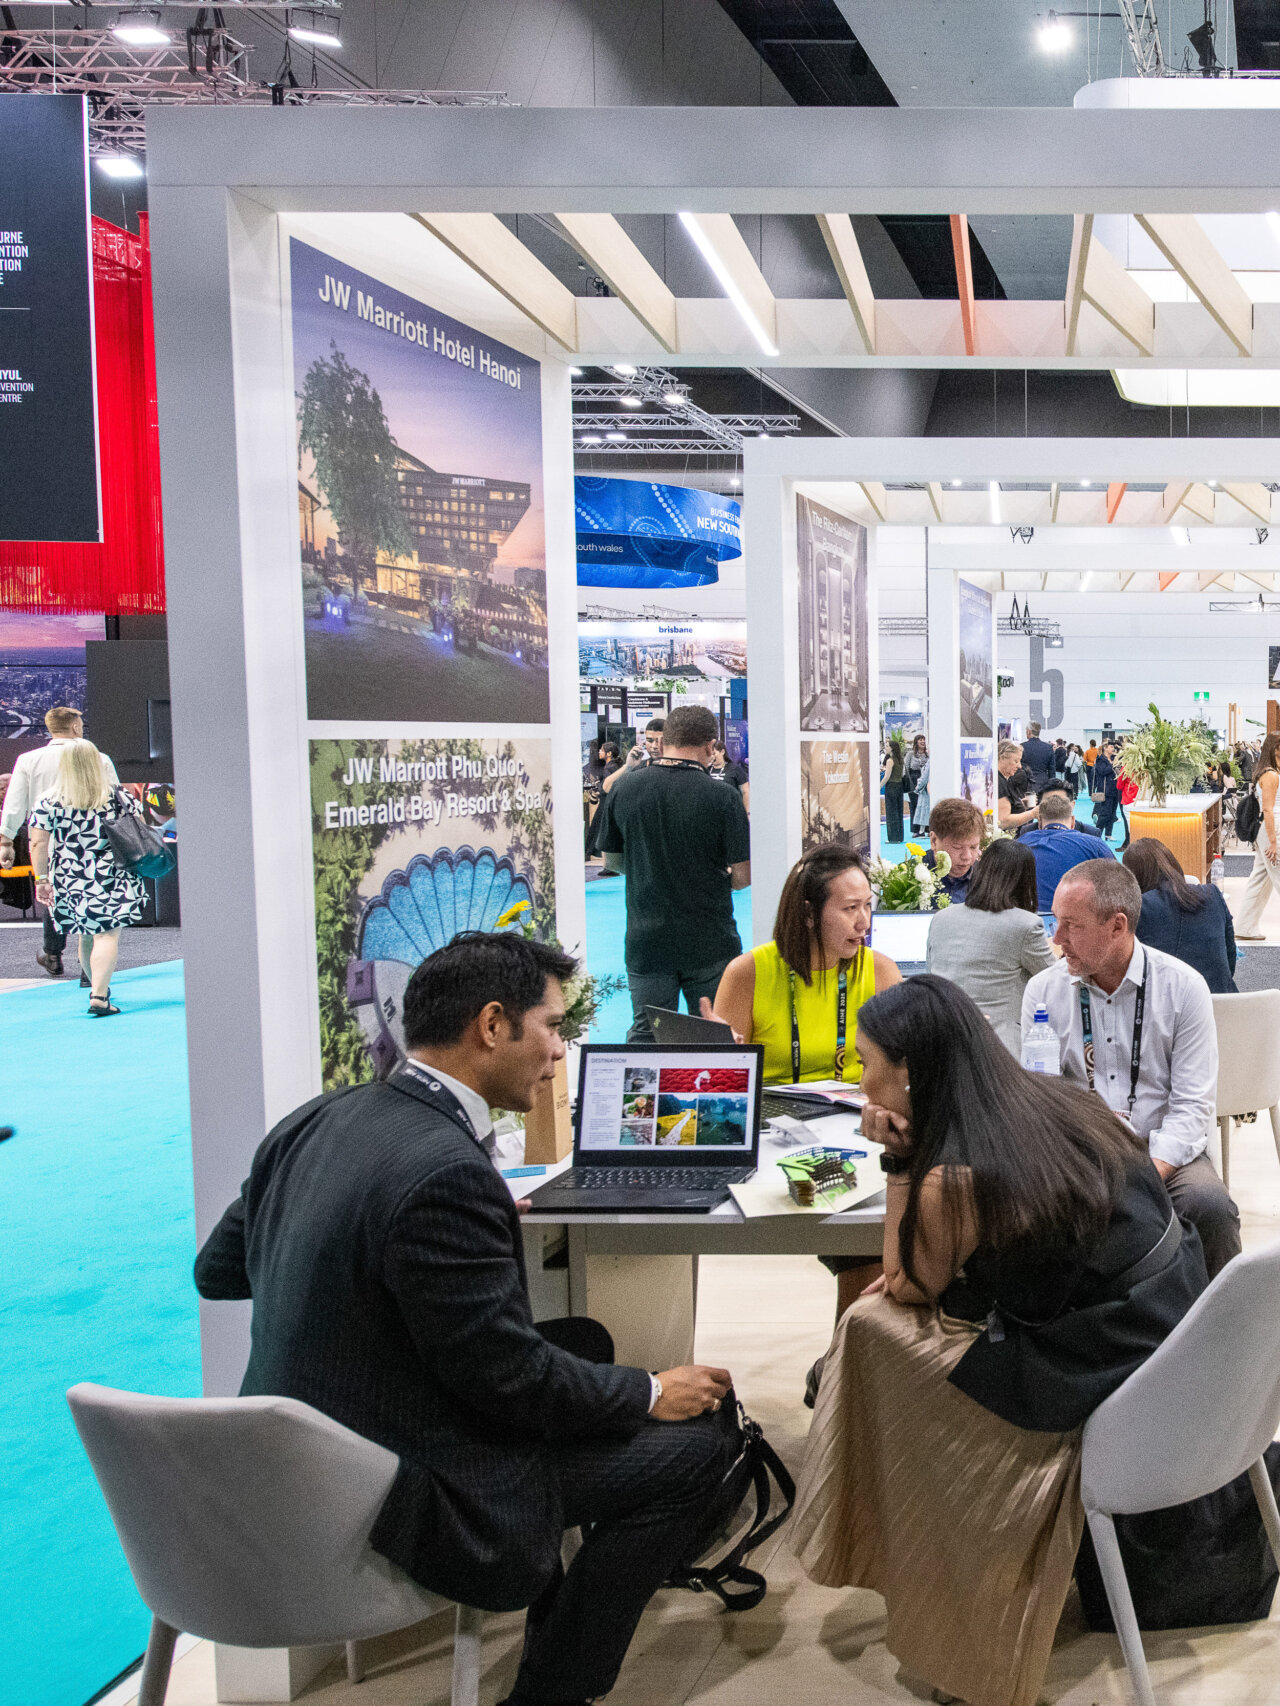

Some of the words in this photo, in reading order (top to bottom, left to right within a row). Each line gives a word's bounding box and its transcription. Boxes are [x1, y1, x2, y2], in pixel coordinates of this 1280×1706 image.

[318, 274, 351, 311] JW
[357, 290, 429, 348] Marriott
[433, 327, 475, 369] Hotel
[479, 349, 521, 390] Hanoi
[710, 507, 735, 522] BUSINESS
[696, 515, 718, 531] NEW
[599, 544, 624, 553] wales
[658, 625, 693, 634] brisbane
[1029, 635, 1064, 730] 5
[822, 750, 833, 763] The
[833, 750, 849, 763] Westin
[343, 757, 374, 785] JW
[379, 756, 448, 783] Marriott
[452, 755, 482, 779] Phu
[486, 755, 525, 778] Quoc
[324, 797, 405, 829] Emerald
[410, 795, 443, 827] Bay
[447, 791, 499, 818] Resort
[500, 789, 512, 812] &
[515, 787, 543, 814] Spa
